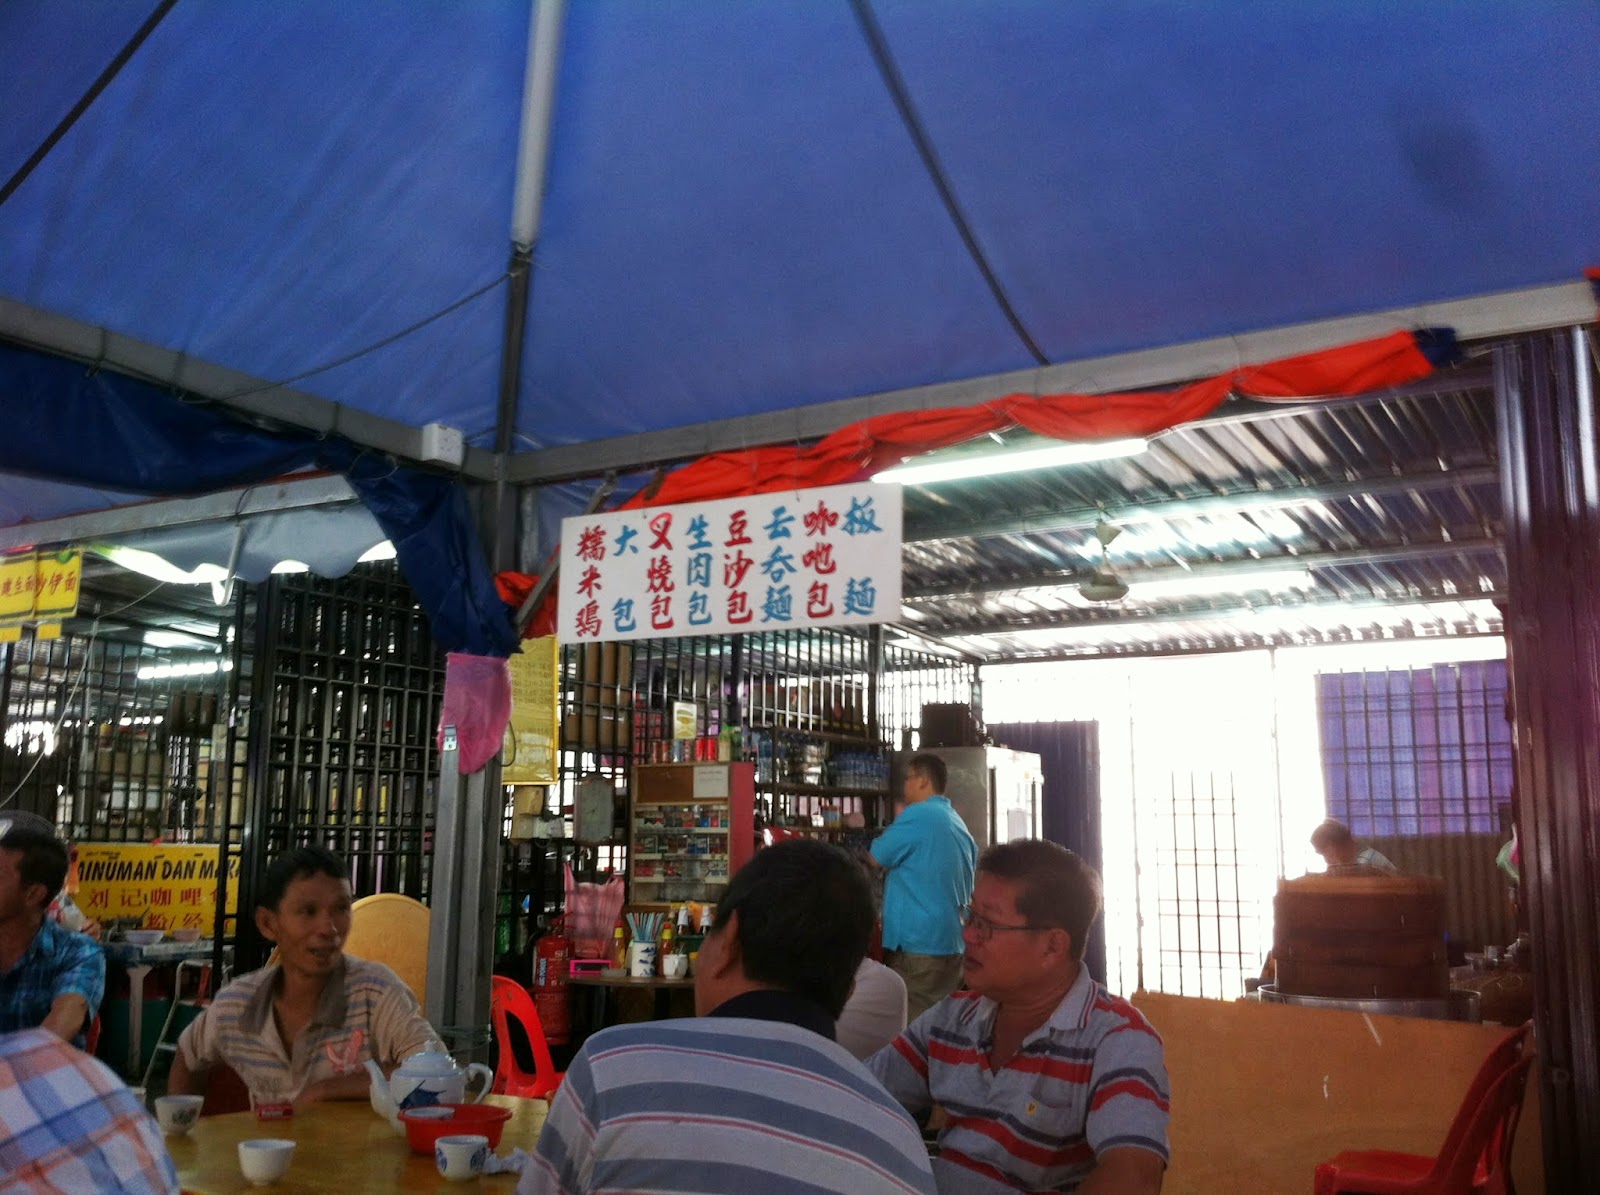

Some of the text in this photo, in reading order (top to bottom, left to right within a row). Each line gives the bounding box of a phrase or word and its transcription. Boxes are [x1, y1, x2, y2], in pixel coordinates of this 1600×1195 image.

[612, 525, 639, 633] 大包
[723, 510, 754, 624] 豆沙包
[161, 860, 196, 880] DAN
